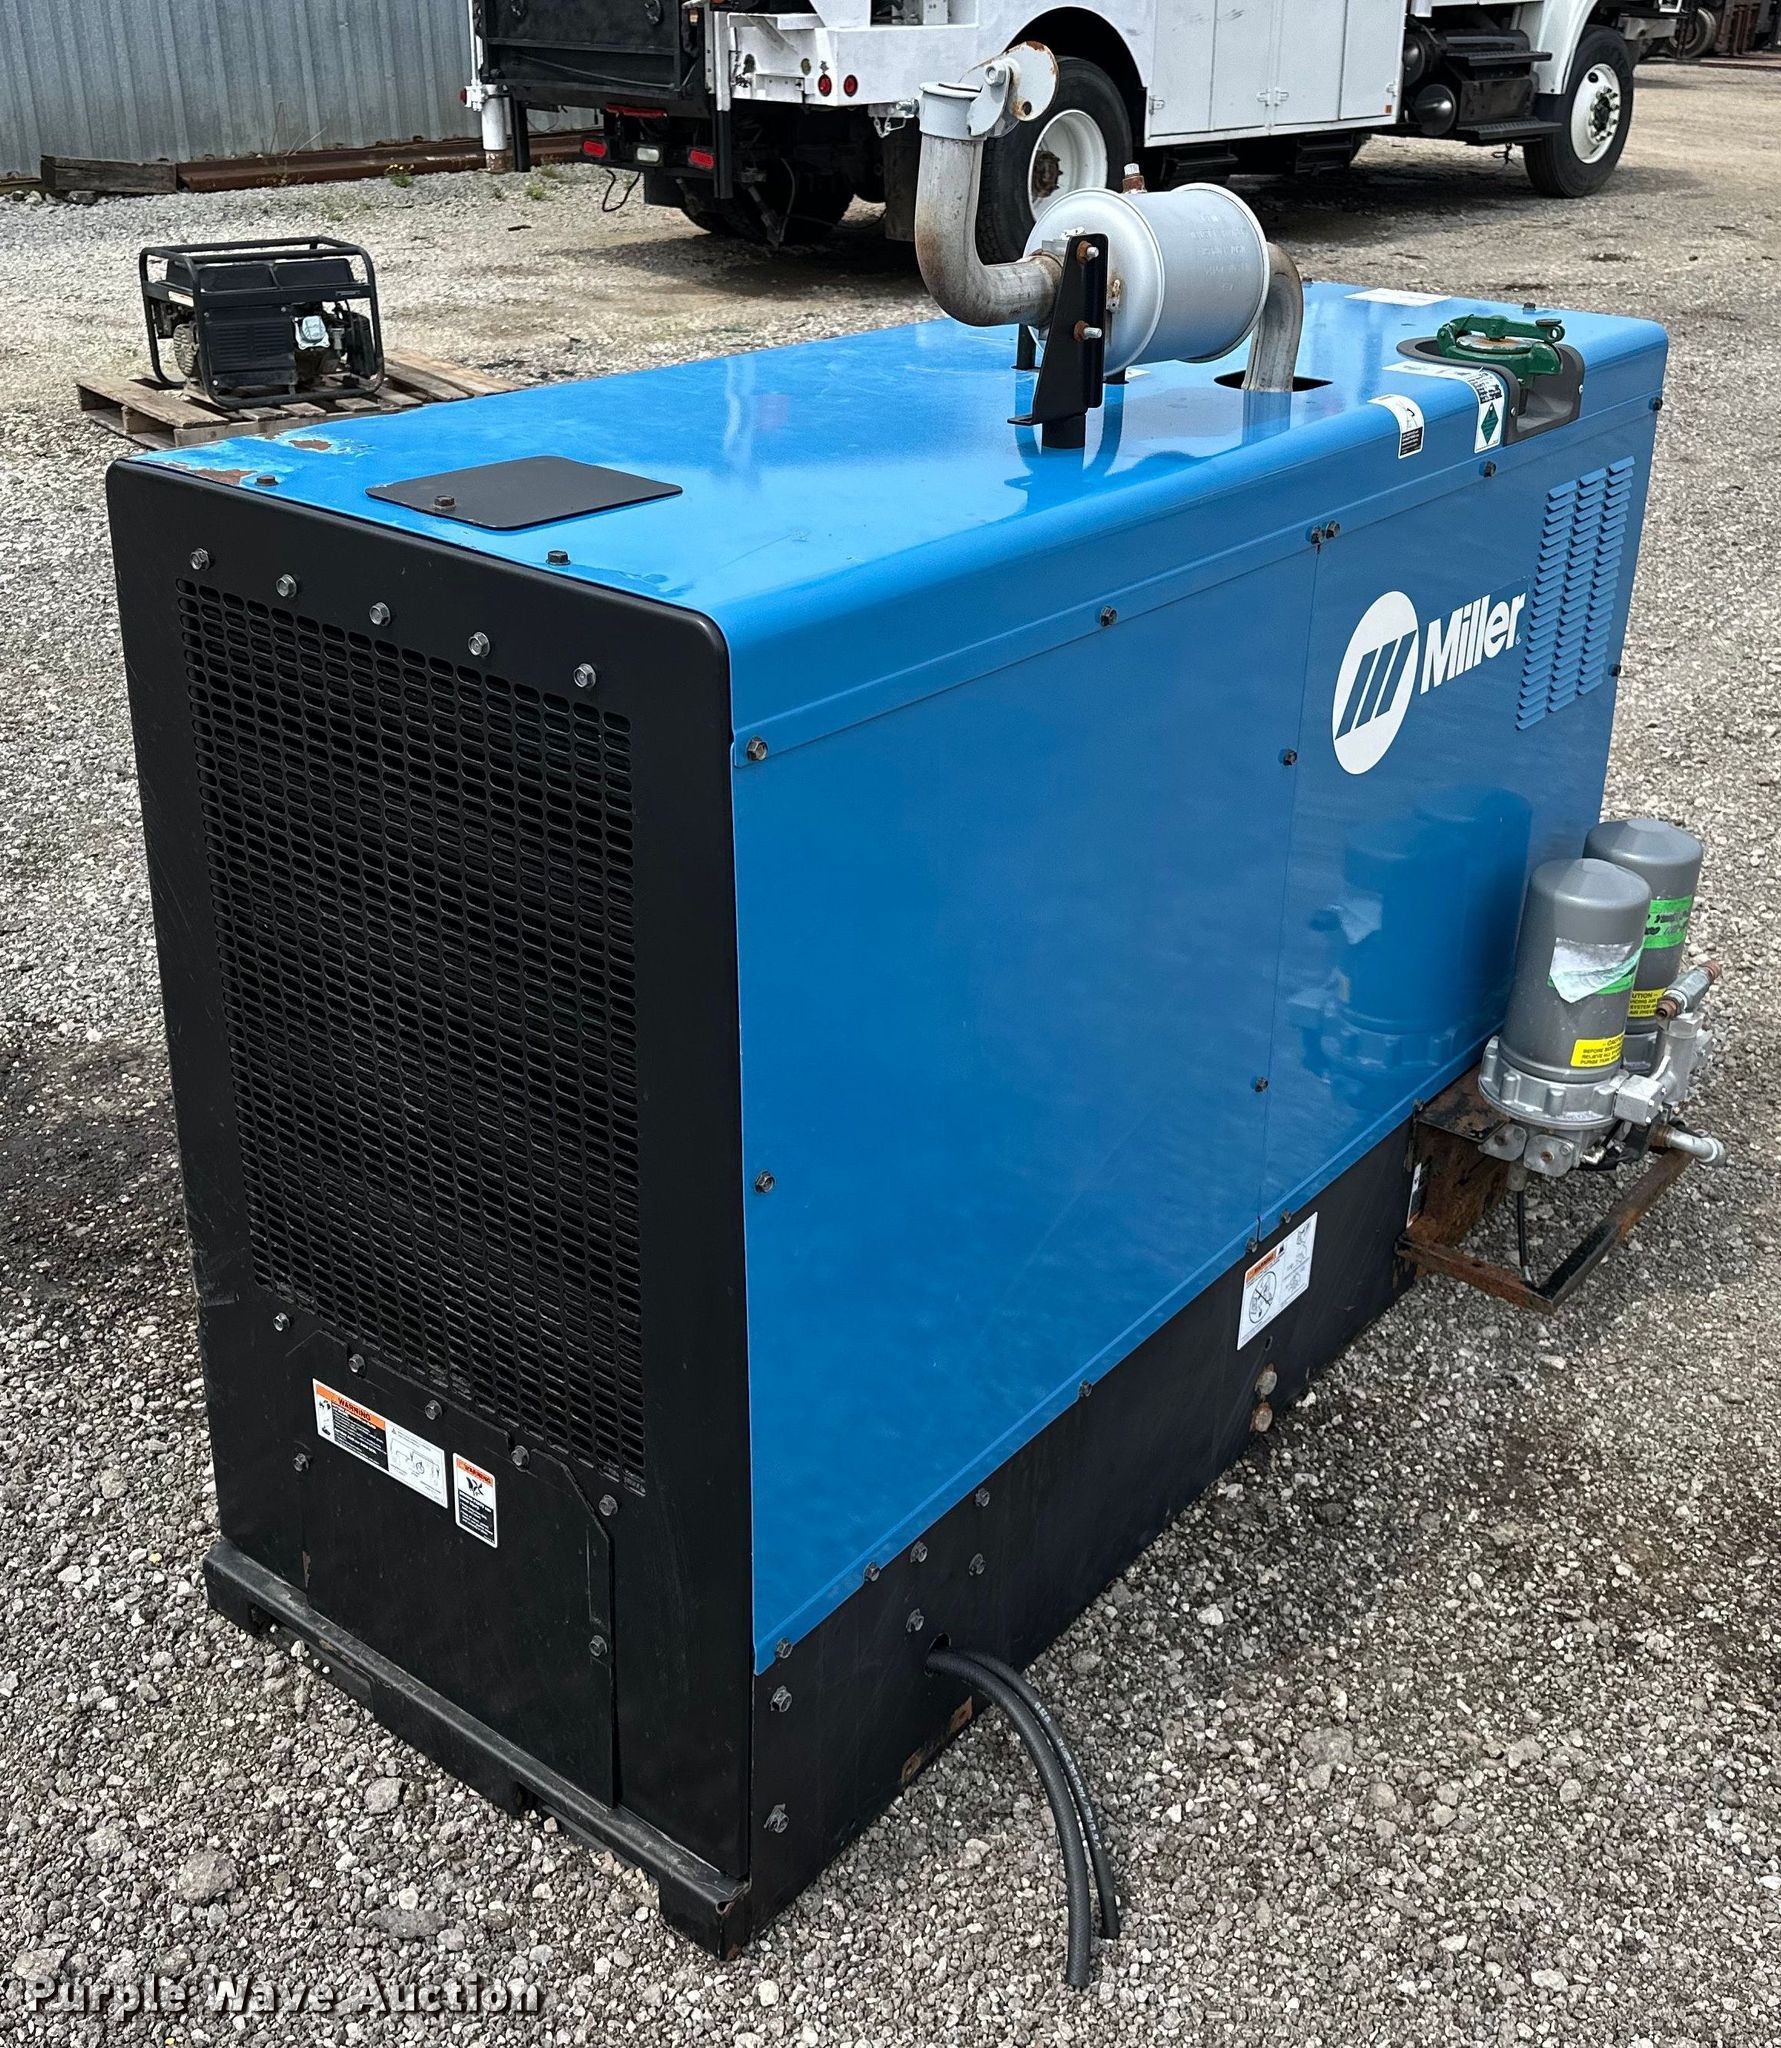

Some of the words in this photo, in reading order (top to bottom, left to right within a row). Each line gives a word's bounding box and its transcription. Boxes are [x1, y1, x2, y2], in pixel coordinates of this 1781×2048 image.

[1420, 592, 1526, 695] Miller
[337, 1397, 372, 1421] WARNING
[1073, 1776, 1086, 1797] VAPOR
[1085, 1806, 1094, 1823] FUEL
